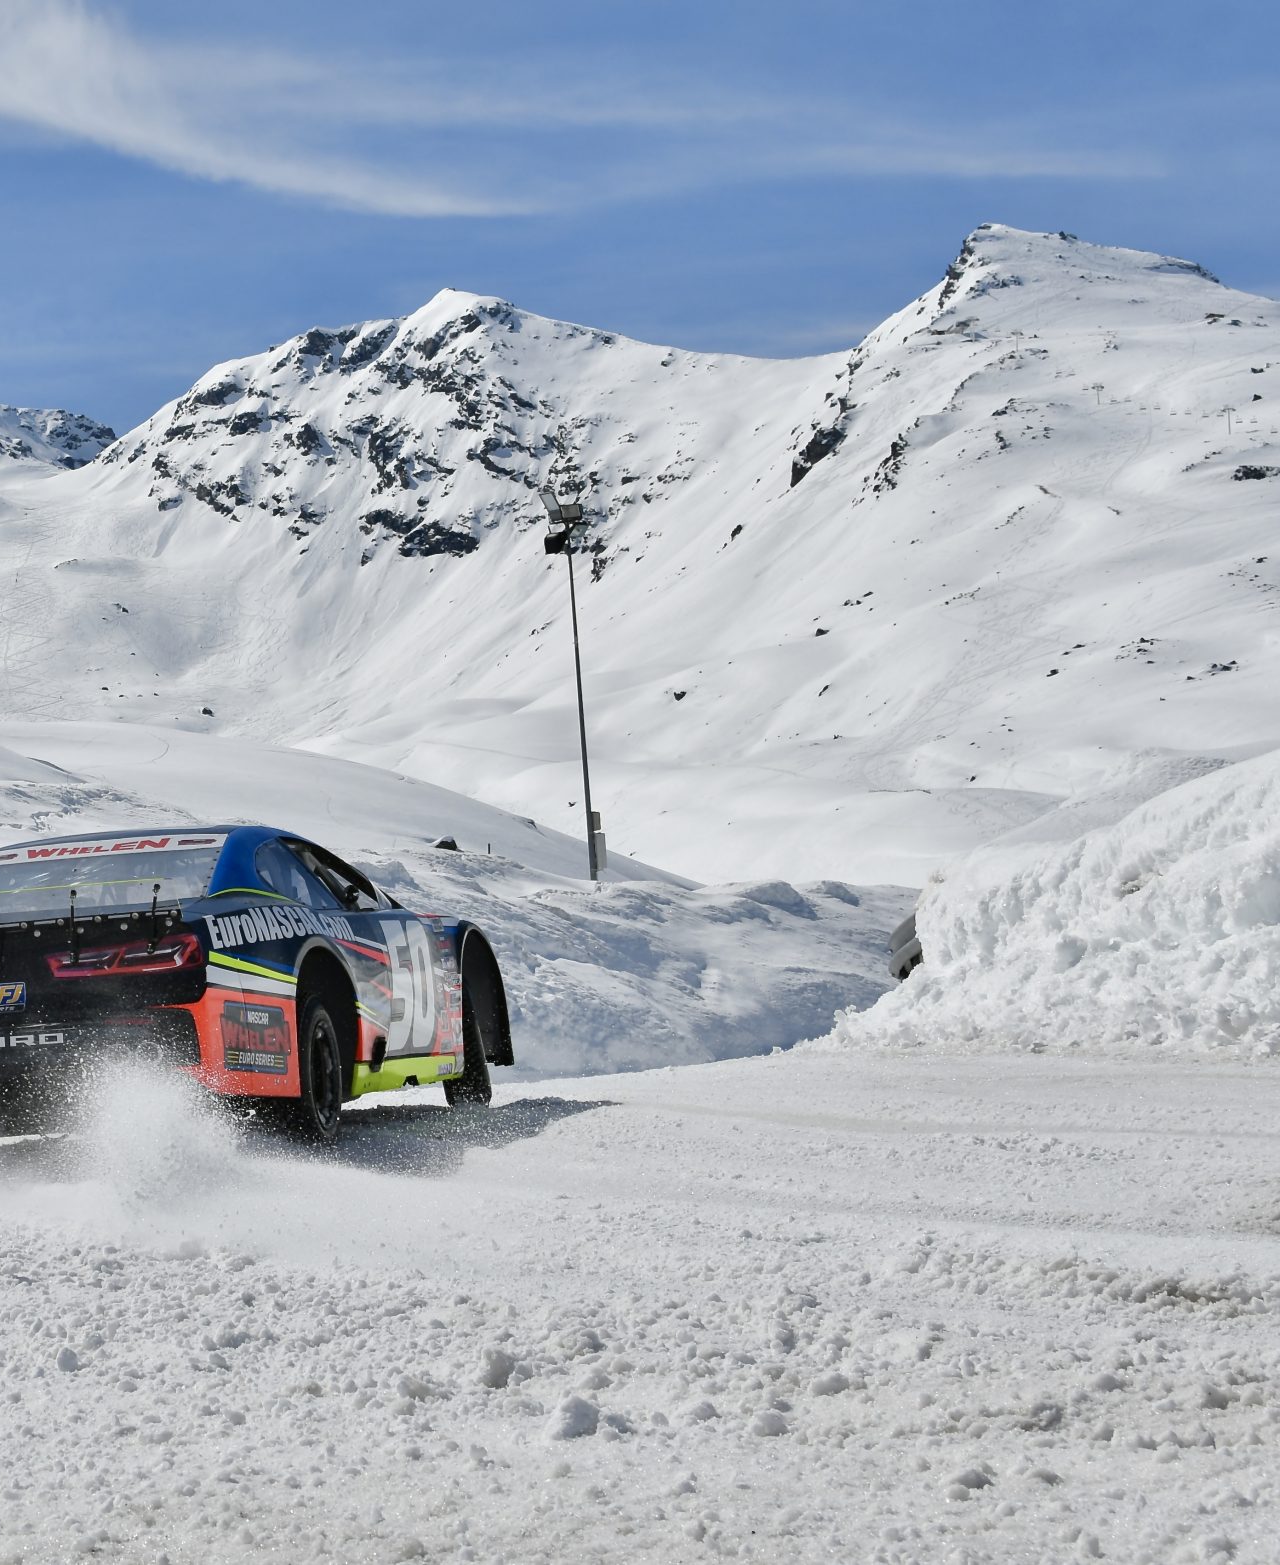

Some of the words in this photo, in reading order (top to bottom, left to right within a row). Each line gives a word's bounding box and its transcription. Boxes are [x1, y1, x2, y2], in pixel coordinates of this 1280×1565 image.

[27, 838, 171, 859] WHELEN
[202, 906, 357, 950] EuroNASCAR.com
[379, 919, 438, 1051] 50
[247, 1010, 269, 1025] NASCAR
[221, 1017, 291, 1055] WHELEN
[238, 1051, 254, 1065] EURO
[255, 1054, 275, 1066] SERIES
